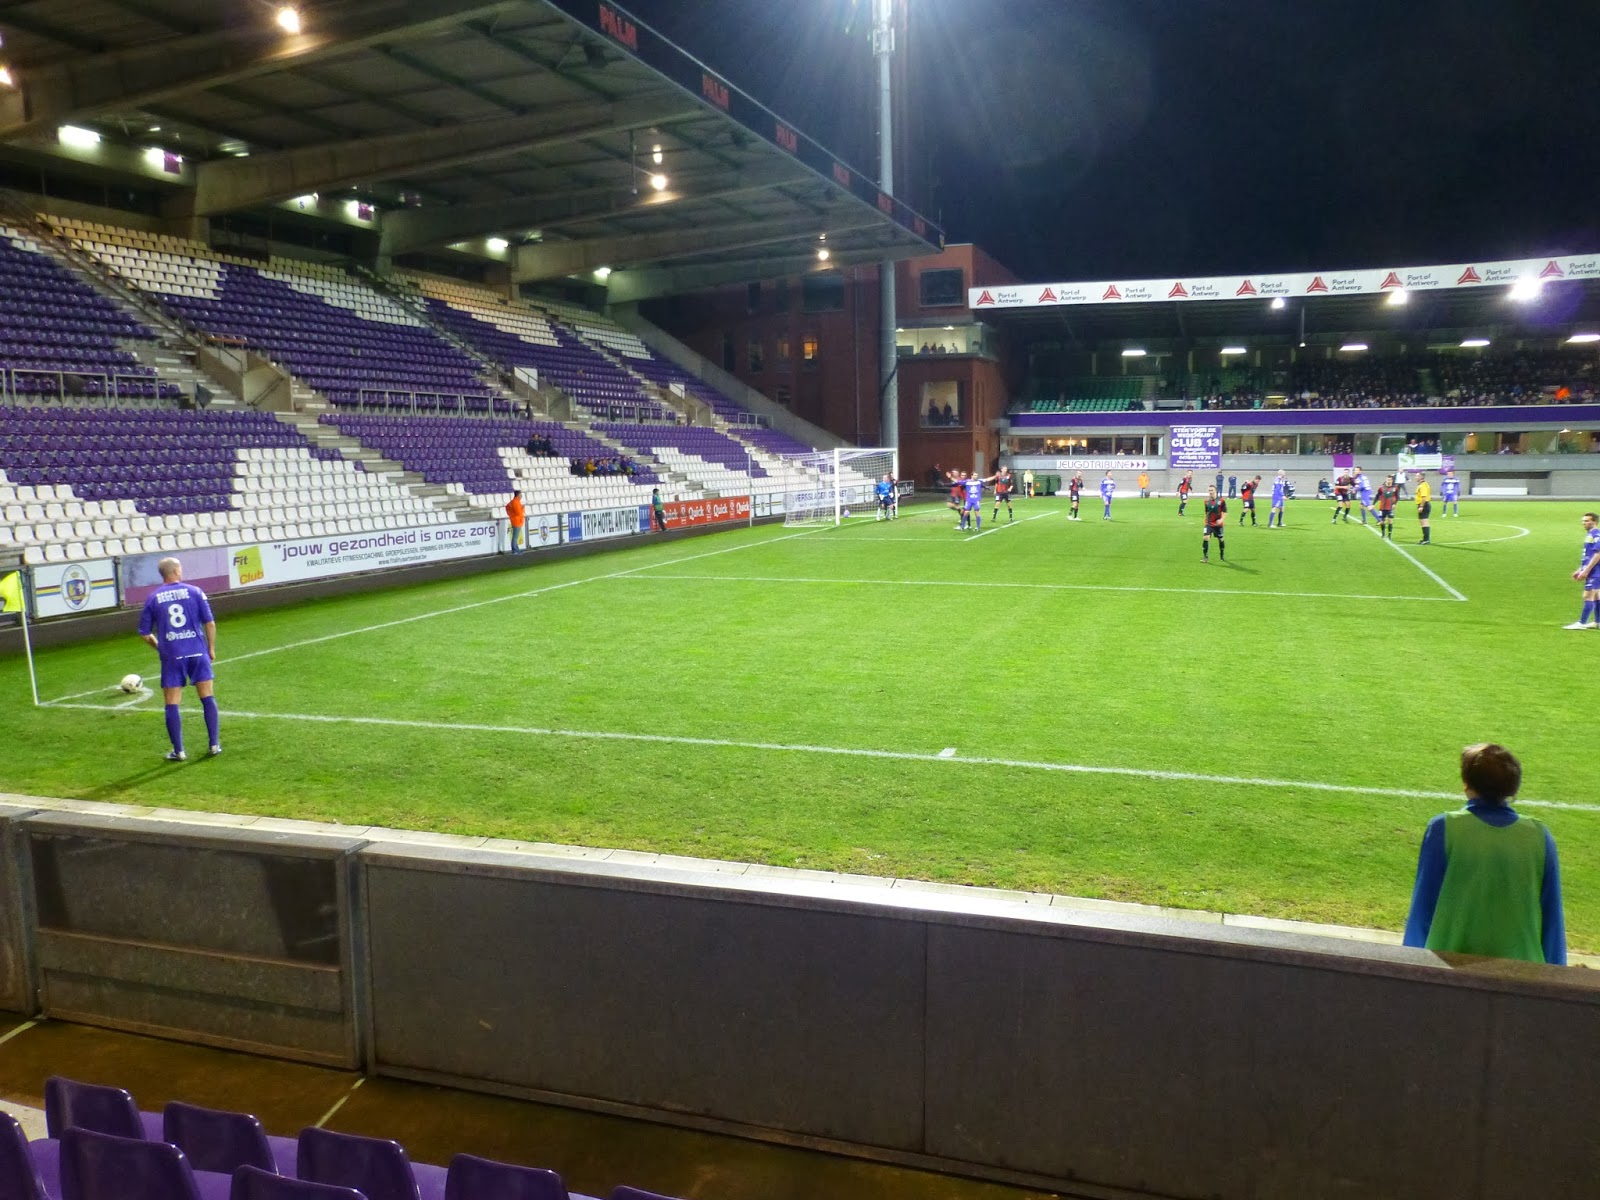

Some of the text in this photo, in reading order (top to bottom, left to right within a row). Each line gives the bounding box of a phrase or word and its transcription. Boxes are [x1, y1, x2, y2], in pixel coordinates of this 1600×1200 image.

[600, 4, 638, 51] PALM
[1171, 438, 1219, 447] CLUB 13
[1058, 461, 1129, 469] JEUGDTRIBUNE
[688, 504, 704, 520] Quick
[713, 503, 728, 517] Quick
[736, 501, 750, 514] Quick
[598, 512, 614, 534] HOTEL
[329, 533, 416, 556] gezondheid
[420, 530, 431, 542] is
[435, 527, 466, 540] onze
[233, 555, 248, 566] Fit
[307, 556, 342, 567] KWALITATIEVE
[240, 570, 264, 585] Club
[168, 604, 187, 628] 8
